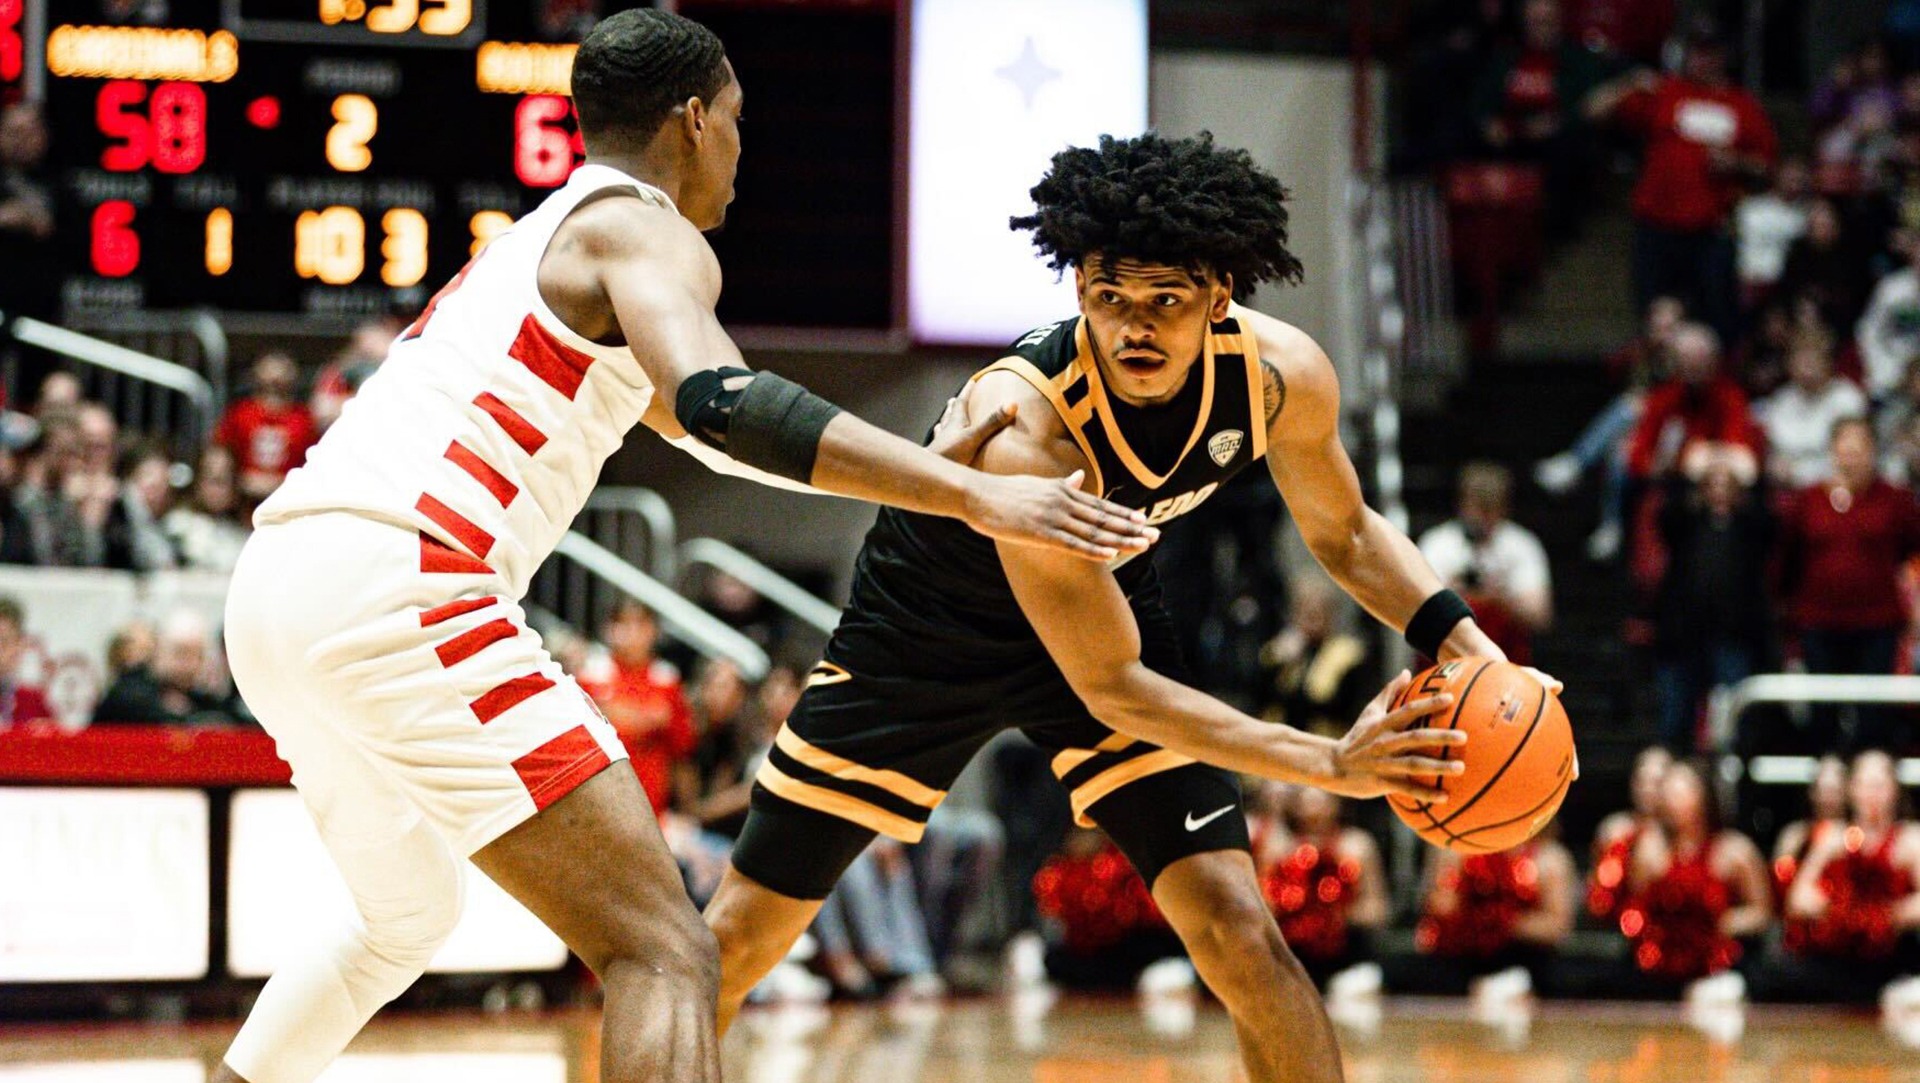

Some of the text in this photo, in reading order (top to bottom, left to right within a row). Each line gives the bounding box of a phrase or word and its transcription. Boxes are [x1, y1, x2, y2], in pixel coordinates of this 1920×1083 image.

[97, 80, 207, 173] 58
[326, 94, 378, 171] 2
[514, 94, 585, 188] 6
[92, 200, 140, 277] 6
[206, 207, 233, 276] 1
[295, 205, 366, 284] 10
[380, 208, 428, 287] 3
[1139, 481, 1219, 526] EDO
